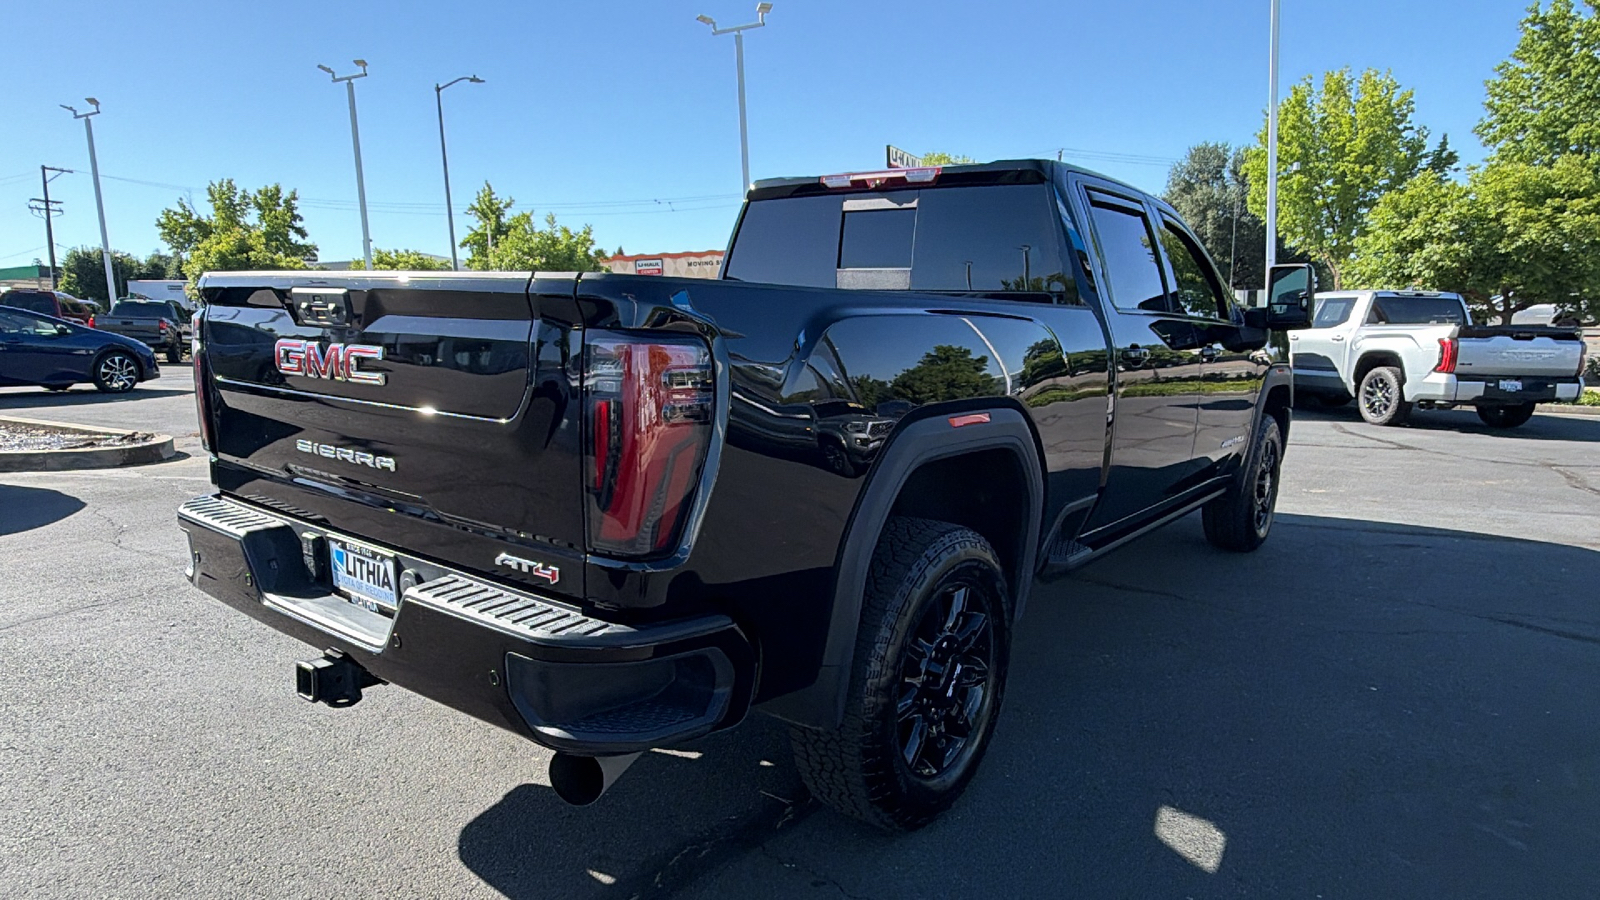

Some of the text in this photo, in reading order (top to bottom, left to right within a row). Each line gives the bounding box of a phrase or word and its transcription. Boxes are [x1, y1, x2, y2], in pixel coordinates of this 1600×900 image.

[274, 338, 386, 386] GMC
[296, 439, 396, 472] SIERRA
[345, 551, 394, 592] LITHIA
[494, 552, 560, 585] AT4
[365, 584, 395, 603] REDDING
